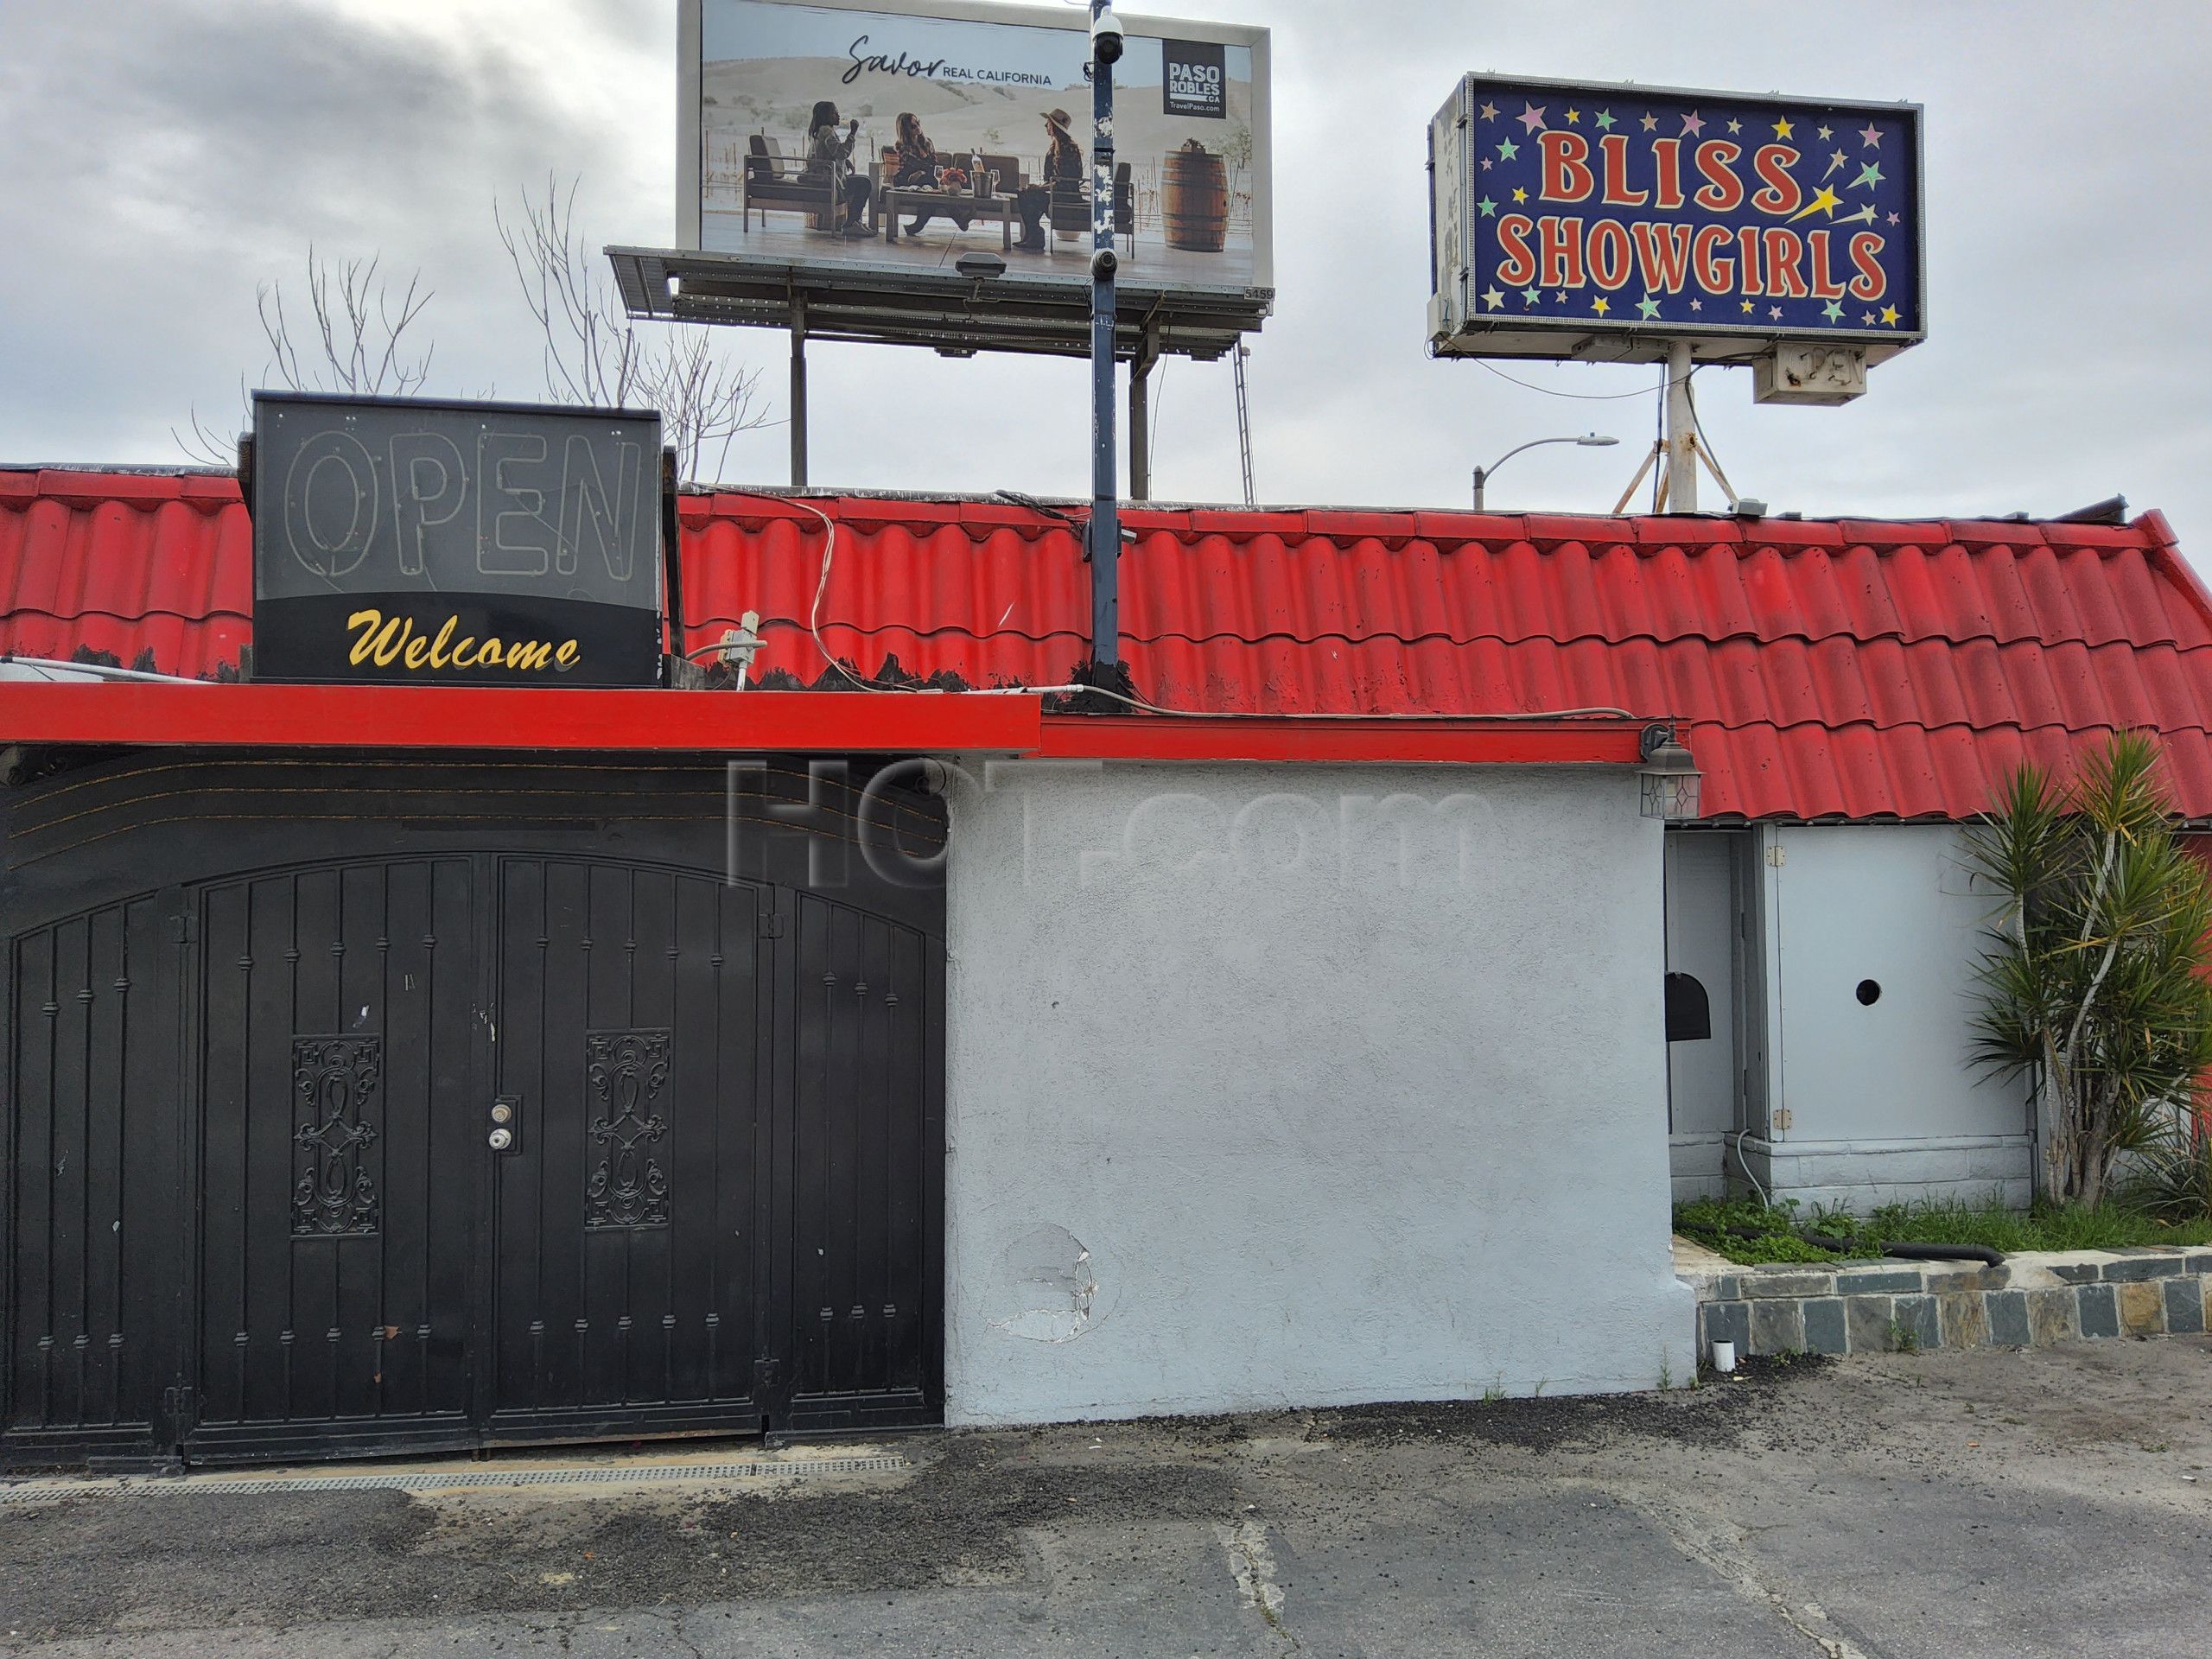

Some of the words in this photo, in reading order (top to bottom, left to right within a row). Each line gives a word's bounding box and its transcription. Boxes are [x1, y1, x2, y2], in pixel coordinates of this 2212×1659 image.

[842, 35, 944, 84] Savor
[943, 67, 973, 79] REAL
[976, 69, 1052, 86] CALIFORNIA
[1169, 62, 1220, 84] PASO
[1169, 80, 1220, 96] ROBLES
[1169, 101, 1220, 111] TravelPaso.com
[1536, 130, 1802, 216] BLISS
[1496, 213, 1886, 302] SHOWGIRLS
[284, 431, 641, 582] OPEN
[347, 609, 581, 671] Welcome
